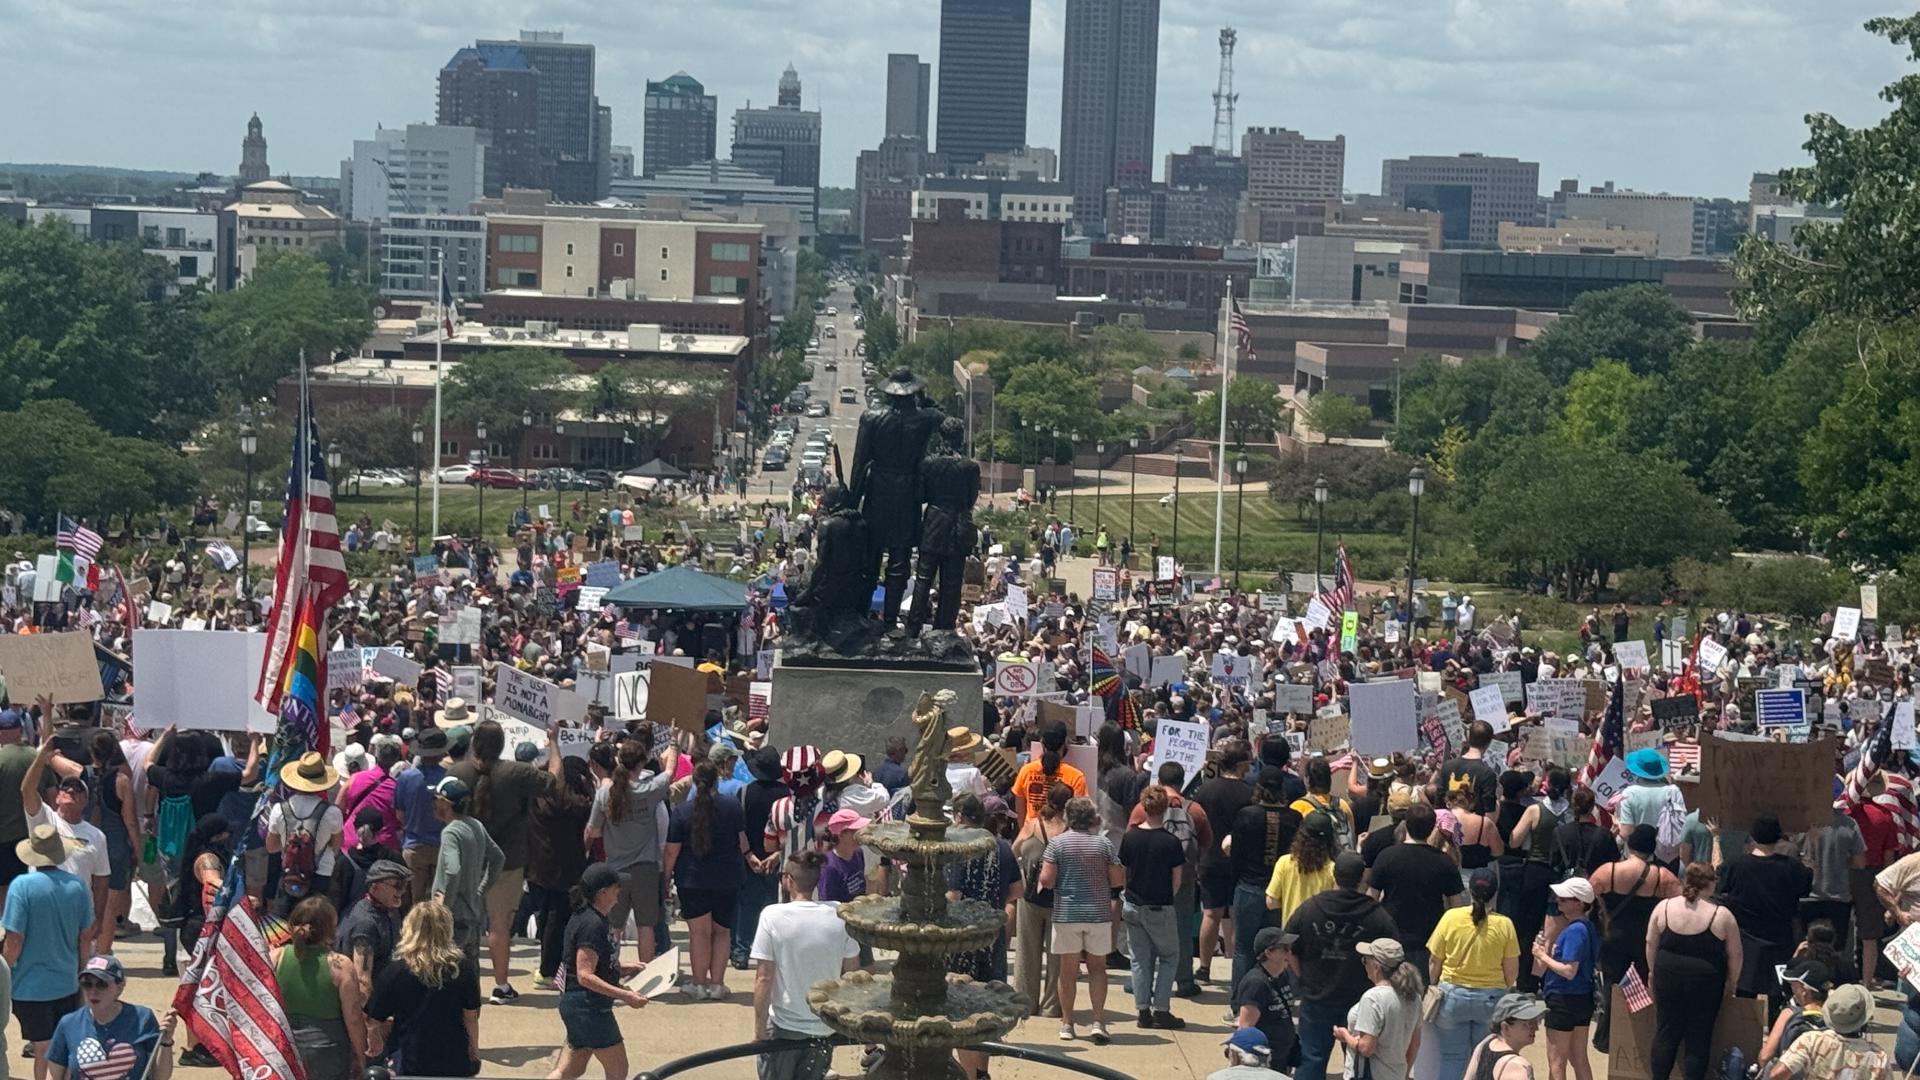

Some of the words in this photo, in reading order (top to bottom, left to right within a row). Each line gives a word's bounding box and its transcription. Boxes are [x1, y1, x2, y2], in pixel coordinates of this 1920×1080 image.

[510, 671, 523, 685] THE
[530, 680, 548, 694] USA
[506, 682, 518, 695] IS
[521, 688, 539, 703] NOT
[540, 696, 548, 709] A
[618, 674, 650, 718] NO
[503, 696, 551, 721] MONARCHY
[1161, 725, 1181, 738] FOR
[1188, 729, 1206, 742] THE
[1165, 749, 1179, 760] BY
[1179, 751, 1196, 763] THE
[1311, 920, 1364, 937] 1977
